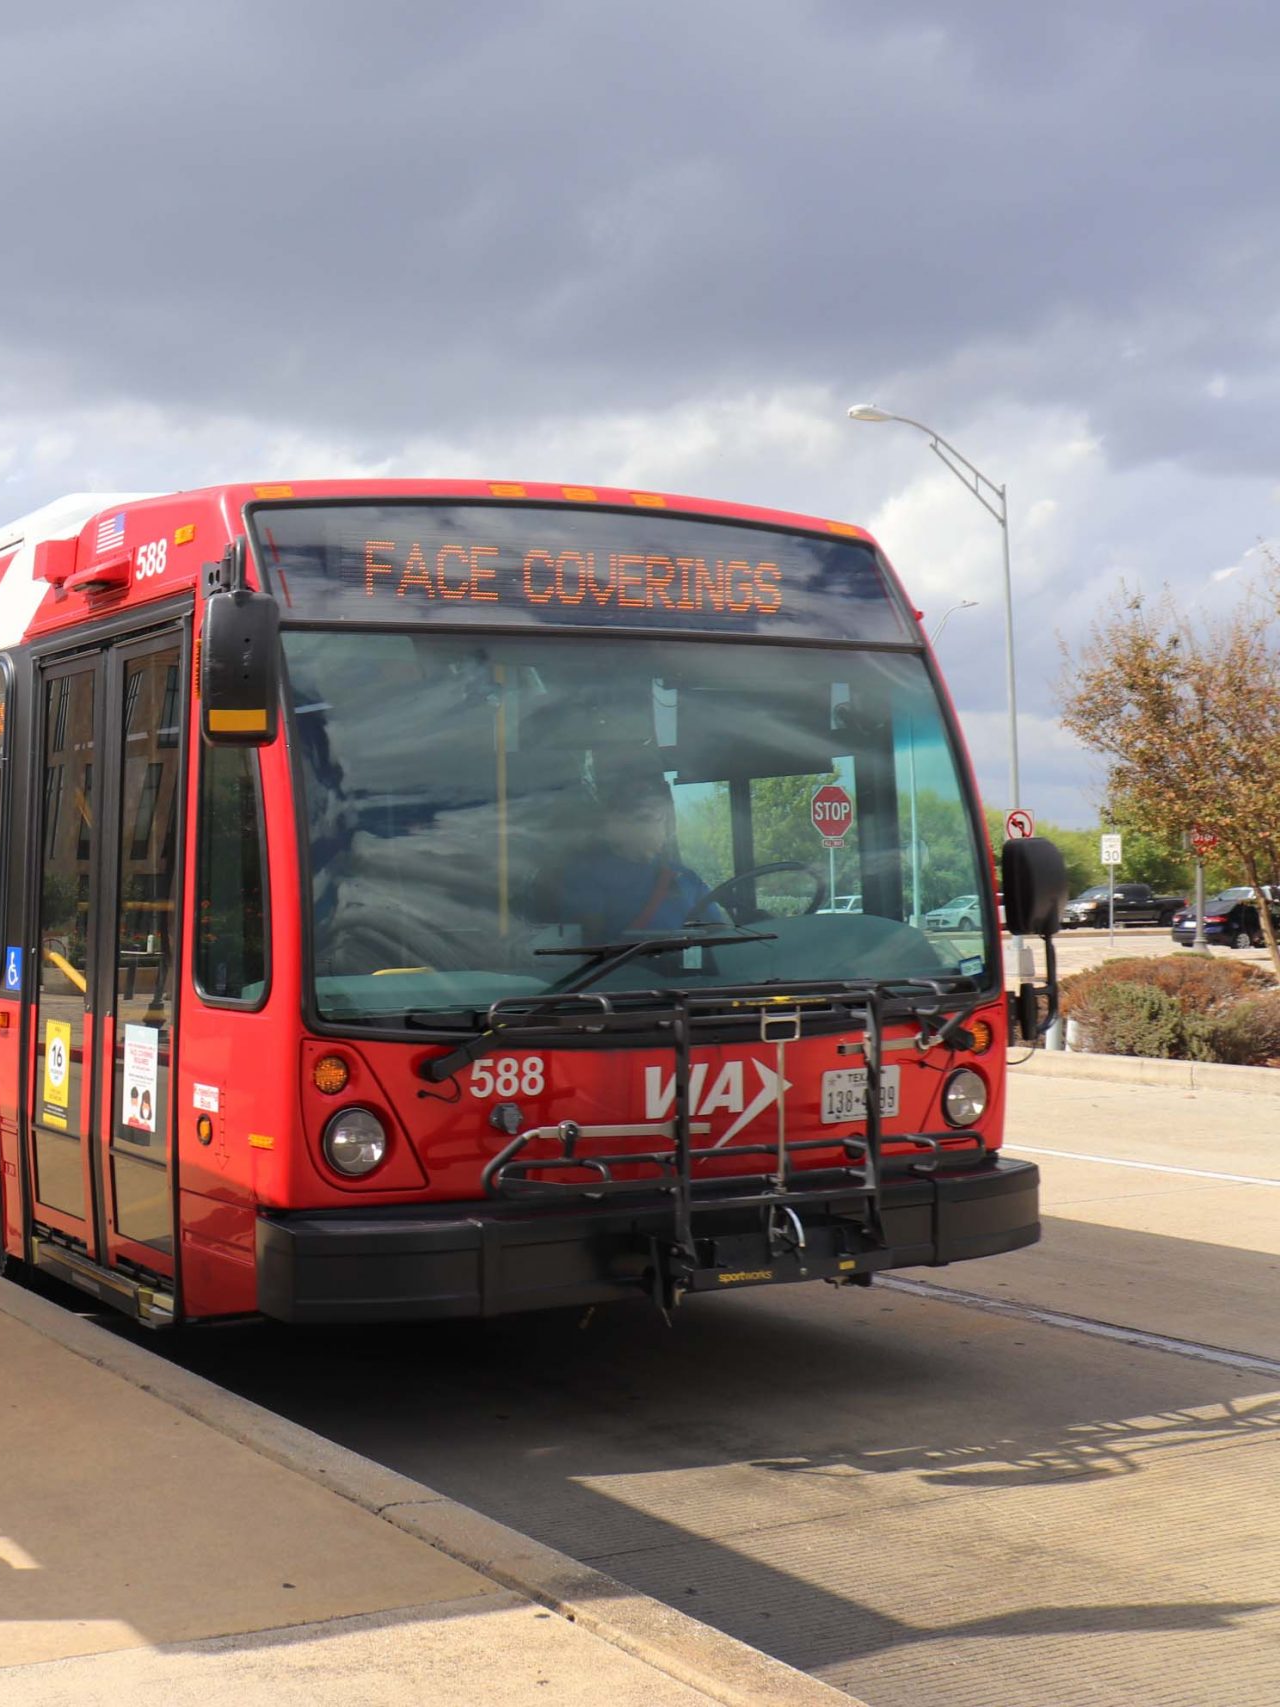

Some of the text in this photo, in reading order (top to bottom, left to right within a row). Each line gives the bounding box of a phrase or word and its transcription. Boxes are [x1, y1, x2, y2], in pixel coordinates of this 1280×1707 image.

[135, 538, 168, 580] 588
[364, 540, 784, 614] FACE COVERINGS
[814, 801, 850, 821] STOP
[1104, 850, 1120, 862] 30
[51, 1045, 63, 1068] 16
[469, 1056, 545, 1098] 588
[644, 1060, 744, 1120] VIA
[718, 1270, 773, 1283] sportworks
